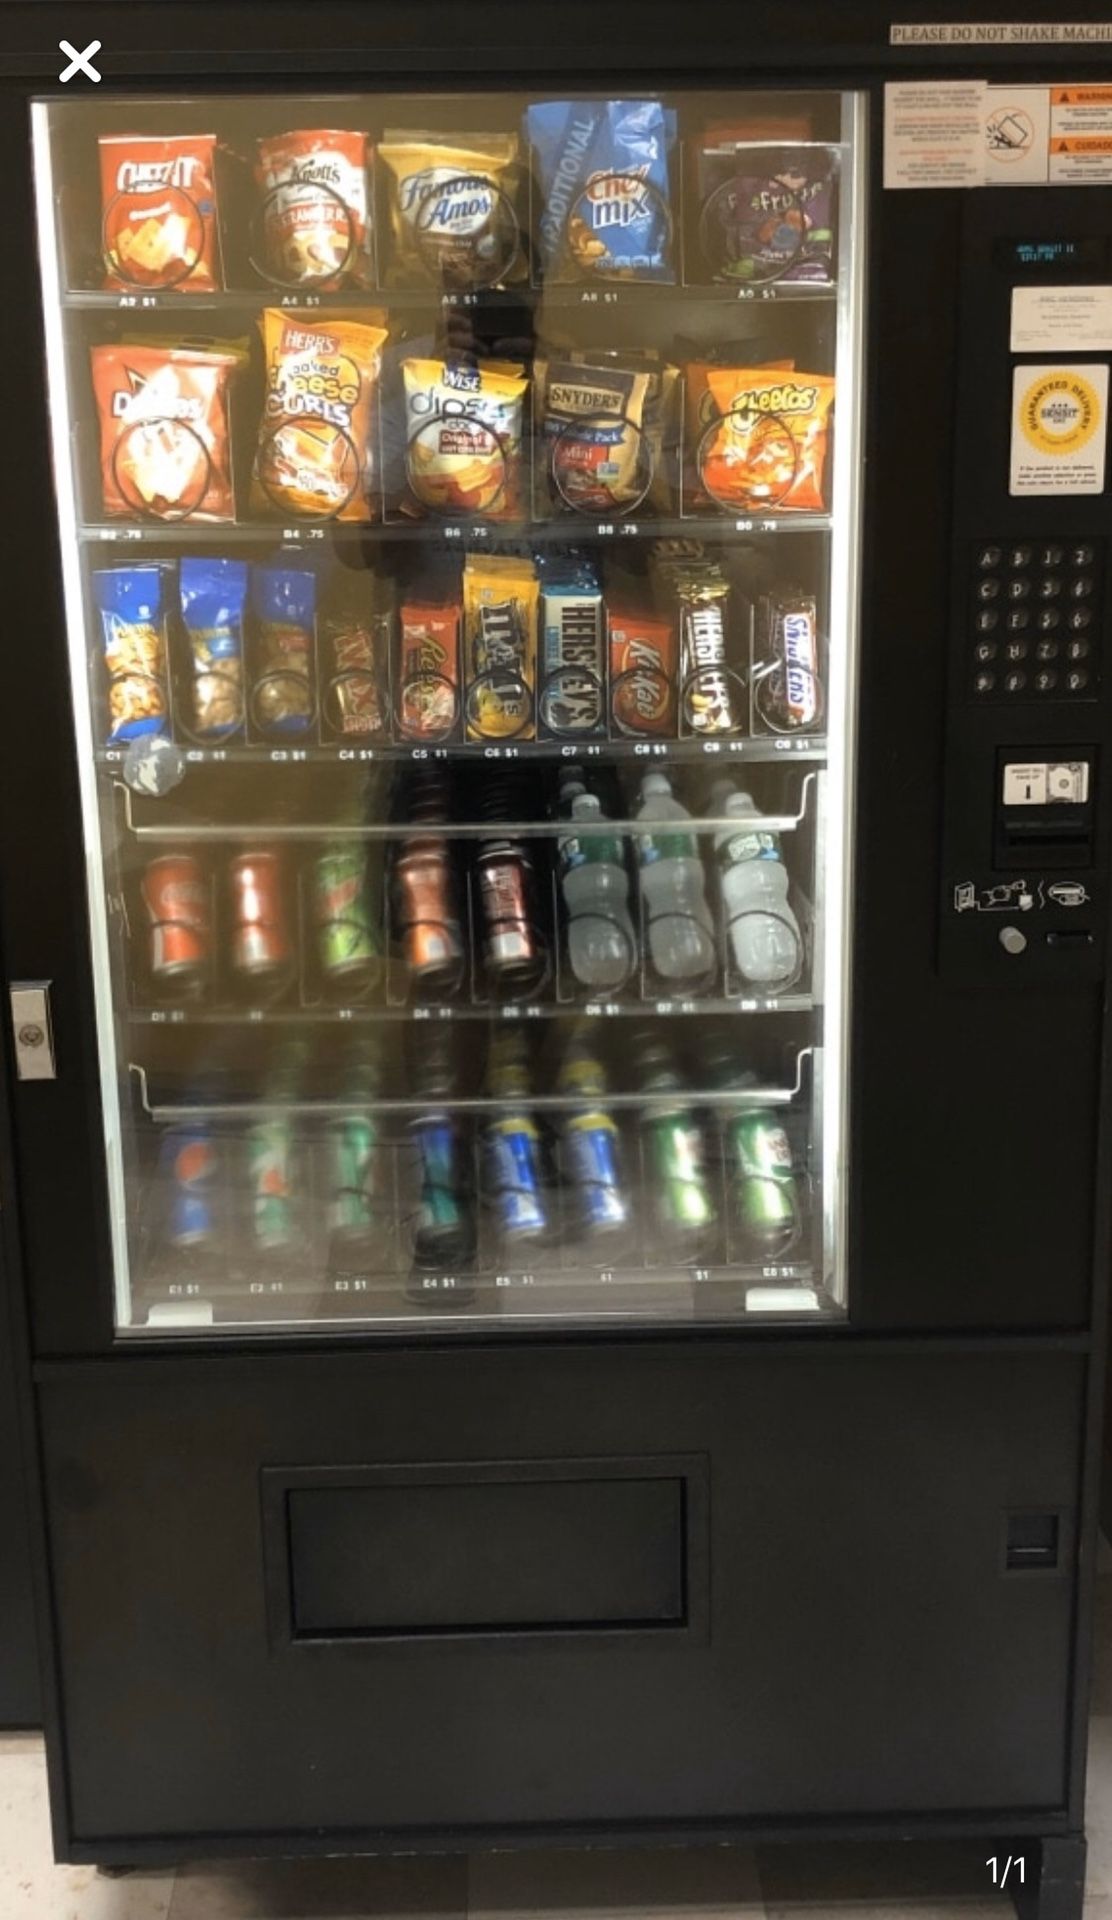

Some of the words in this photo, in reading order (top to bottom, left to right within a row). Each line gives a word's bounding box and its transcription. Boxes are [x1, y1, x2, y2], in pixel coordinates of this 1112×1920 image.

[893, 27, 947, 41] PLEASE
[952, 27, 972, 41] DO
[976, 27, 1007, 40] NOT
[1010, 26, 1059, 40] SHAKE
[562, 746, 577, 756] C7
